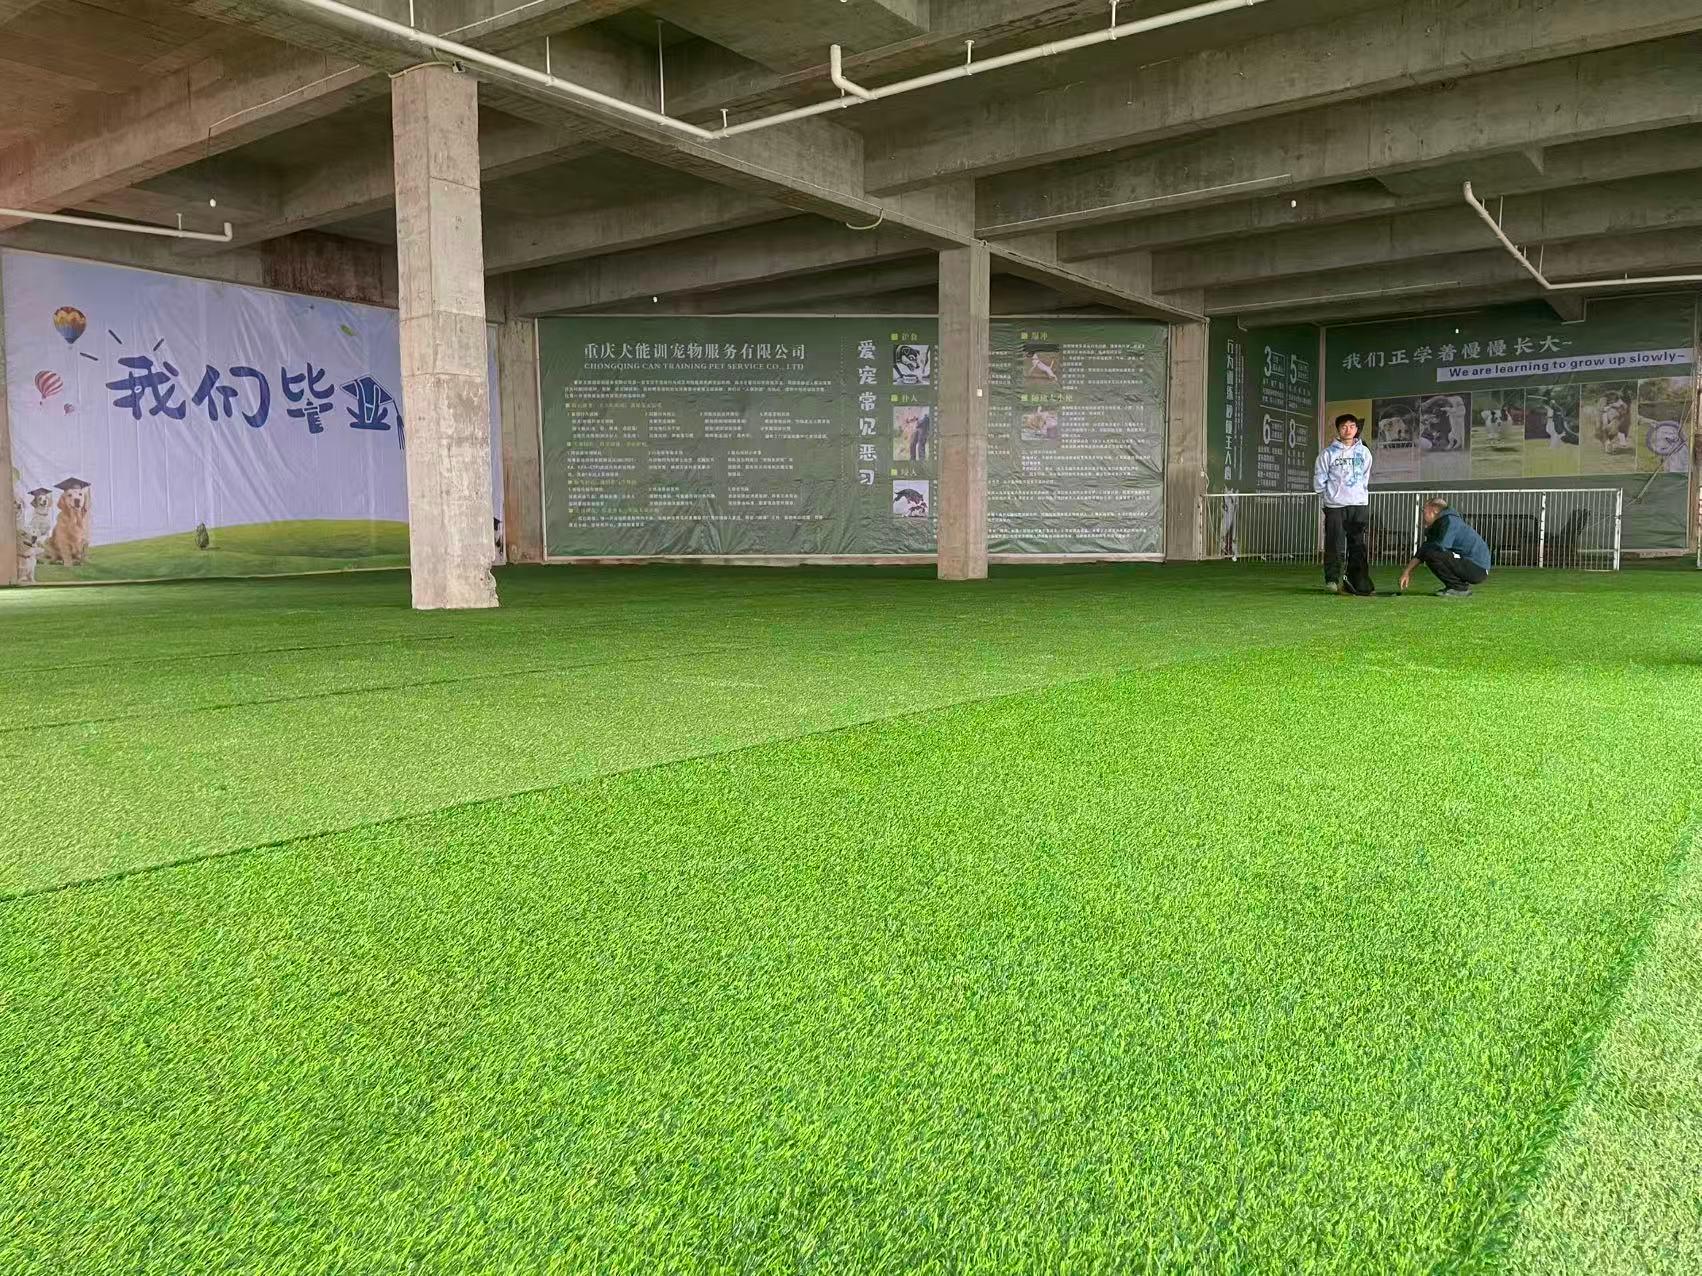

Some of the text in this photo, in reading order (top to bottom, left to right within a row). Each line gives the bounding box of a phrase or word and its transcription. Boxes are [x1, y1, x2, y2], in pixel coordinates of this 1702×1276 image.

[584, 342, 805, 360] 重庆犬能训宠物服务有限公司
[584, 362, 640, 370] CHONGQING
[642, 362, 661, 370] CAN
[662, 362, 707, 370] TRAINING
[1264, 345, 1272, 377] 3
[1289, 354, 1298, 384] 5
[1449, 367, 1469, 378] We
[1472, 367, 1492, 377] are
[1495, 362, 1549, 374] learning
[1553, 360, 1567, 369] to
[1570, 357, 1605, 370] grow
[1609, 356, 1626, 367] up
[857, 339, 878, 487] 爱宠常见恶习
[1262, 413, 1271, 445] 6
[1288, 418, 1296, 449] 8
